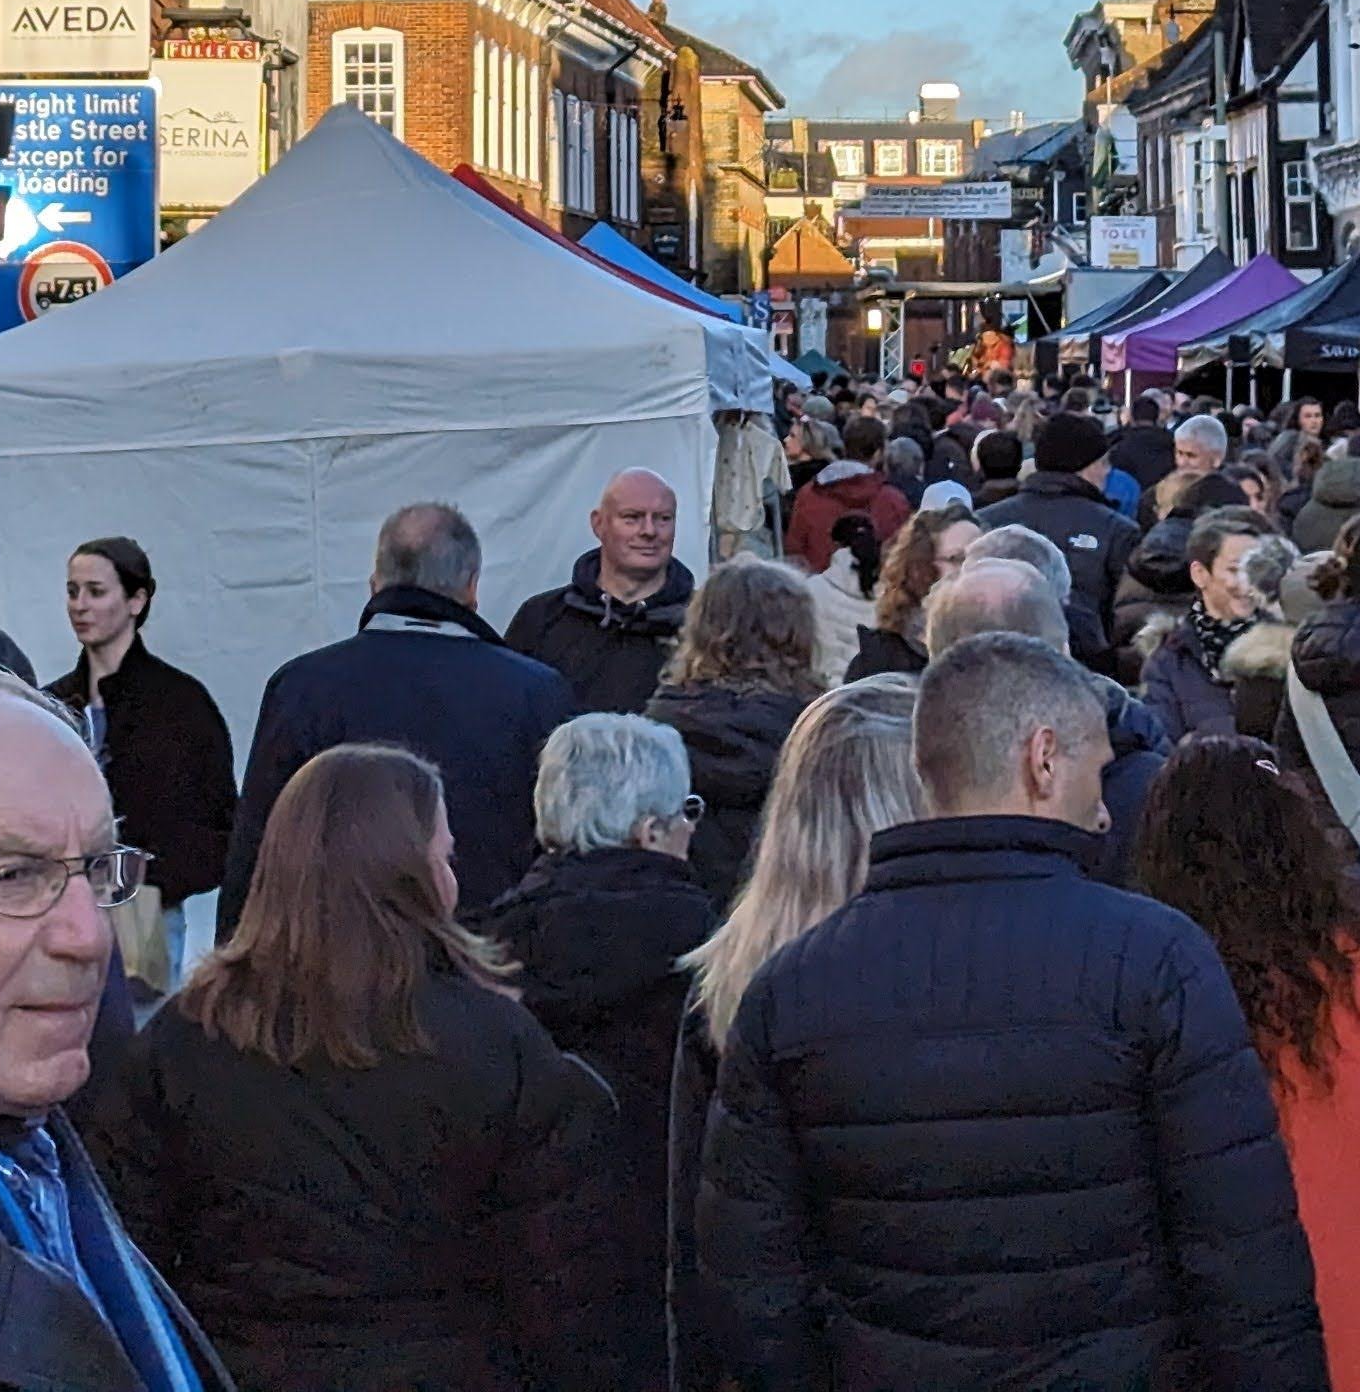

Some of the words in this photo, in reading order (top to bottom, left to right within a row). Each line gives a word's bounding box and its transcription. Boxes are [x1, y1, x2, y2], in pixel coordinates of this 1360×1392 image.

[12, 6, 136, 32] AVEDA
[85, 93, 140, 115] limit
[15, 121, 62, 140] stle
[70, 120, 148, 140] Street
[93, 145, 128, 166] for
[17, 169, 109, 196] loading
[1100, 229, 1120, 240] TO
[1123, 229, 1147, 240] LET
